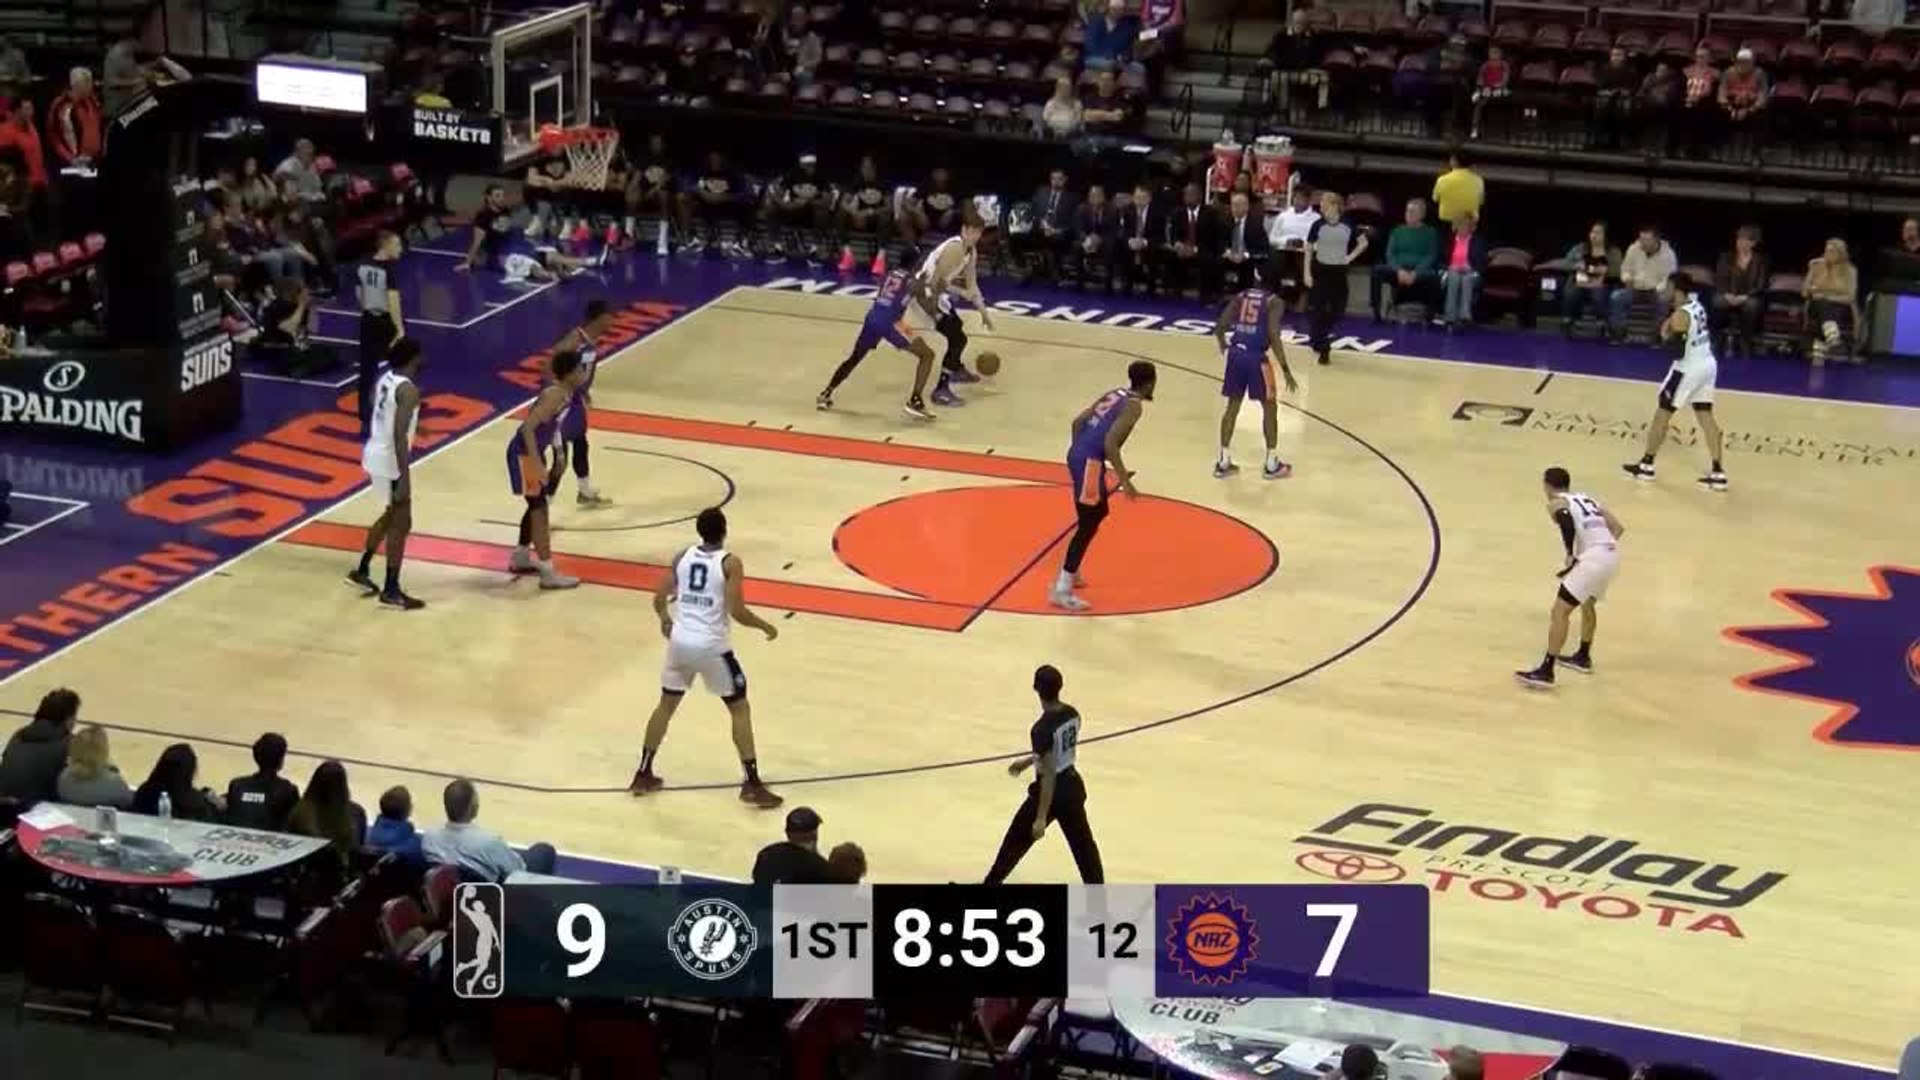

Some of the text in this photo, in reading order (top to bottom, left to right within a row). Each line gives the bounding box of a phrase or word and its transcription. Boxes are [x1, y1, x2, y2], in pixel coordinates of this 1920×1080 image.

[1240, 298, 1261, 324] 15
[181, 340, 233, 392] SUNS
[125, 391, 497, 539] SUNS
[689, 563, 708, 592] 0
[193, 848, 260, 866] CLUB
[1292, 803, 1790, 909] Findlay
[1425, 854, 1617, 893] PRESCOTT
[1425, 867, 1747, 939] TOYOTA
[1150, 1003, 1221, 1025] CLUB
